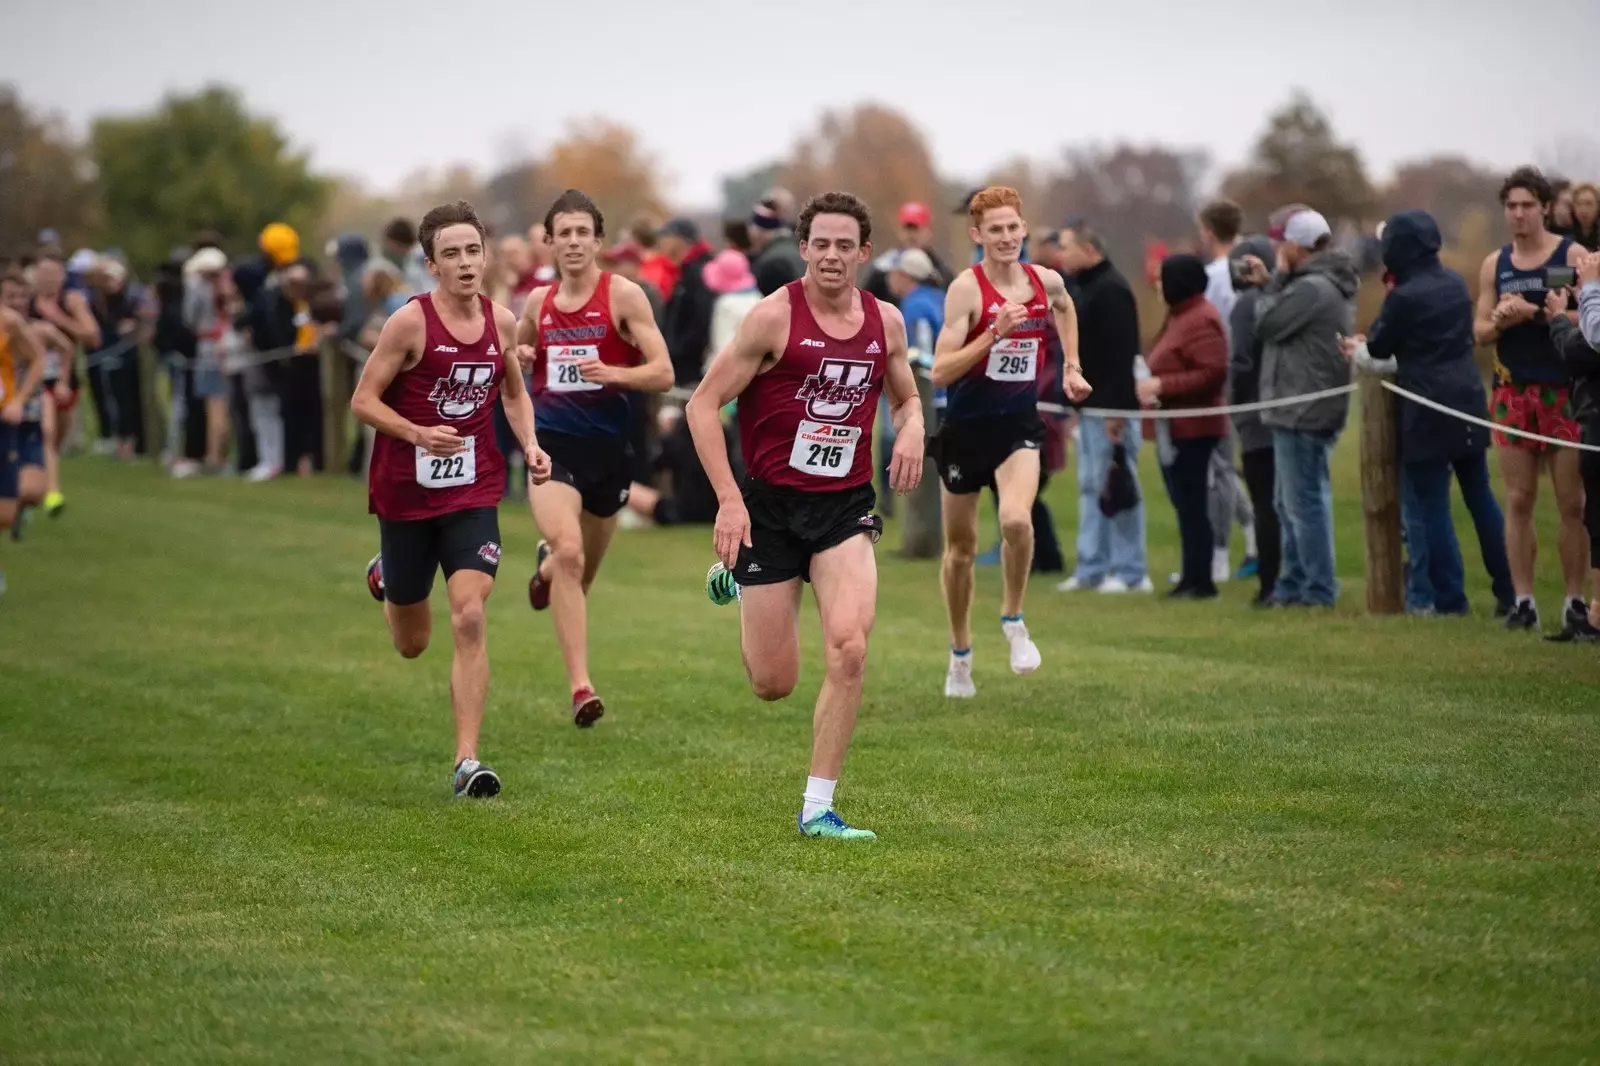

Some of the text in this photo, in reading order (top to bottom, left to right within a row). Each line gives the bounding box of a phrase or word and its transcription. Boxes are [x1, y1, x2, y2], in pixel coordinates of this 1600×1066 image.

[799, 338, 825, 348] A10
[997, 355, 1028, 375] 295
[801, 432, 854, 444] CHAMPIONSHIPS
[813, 424, 851, 438] A10
[806, 443, 844, 468] 215
[430, 456, 464, 480] 222
